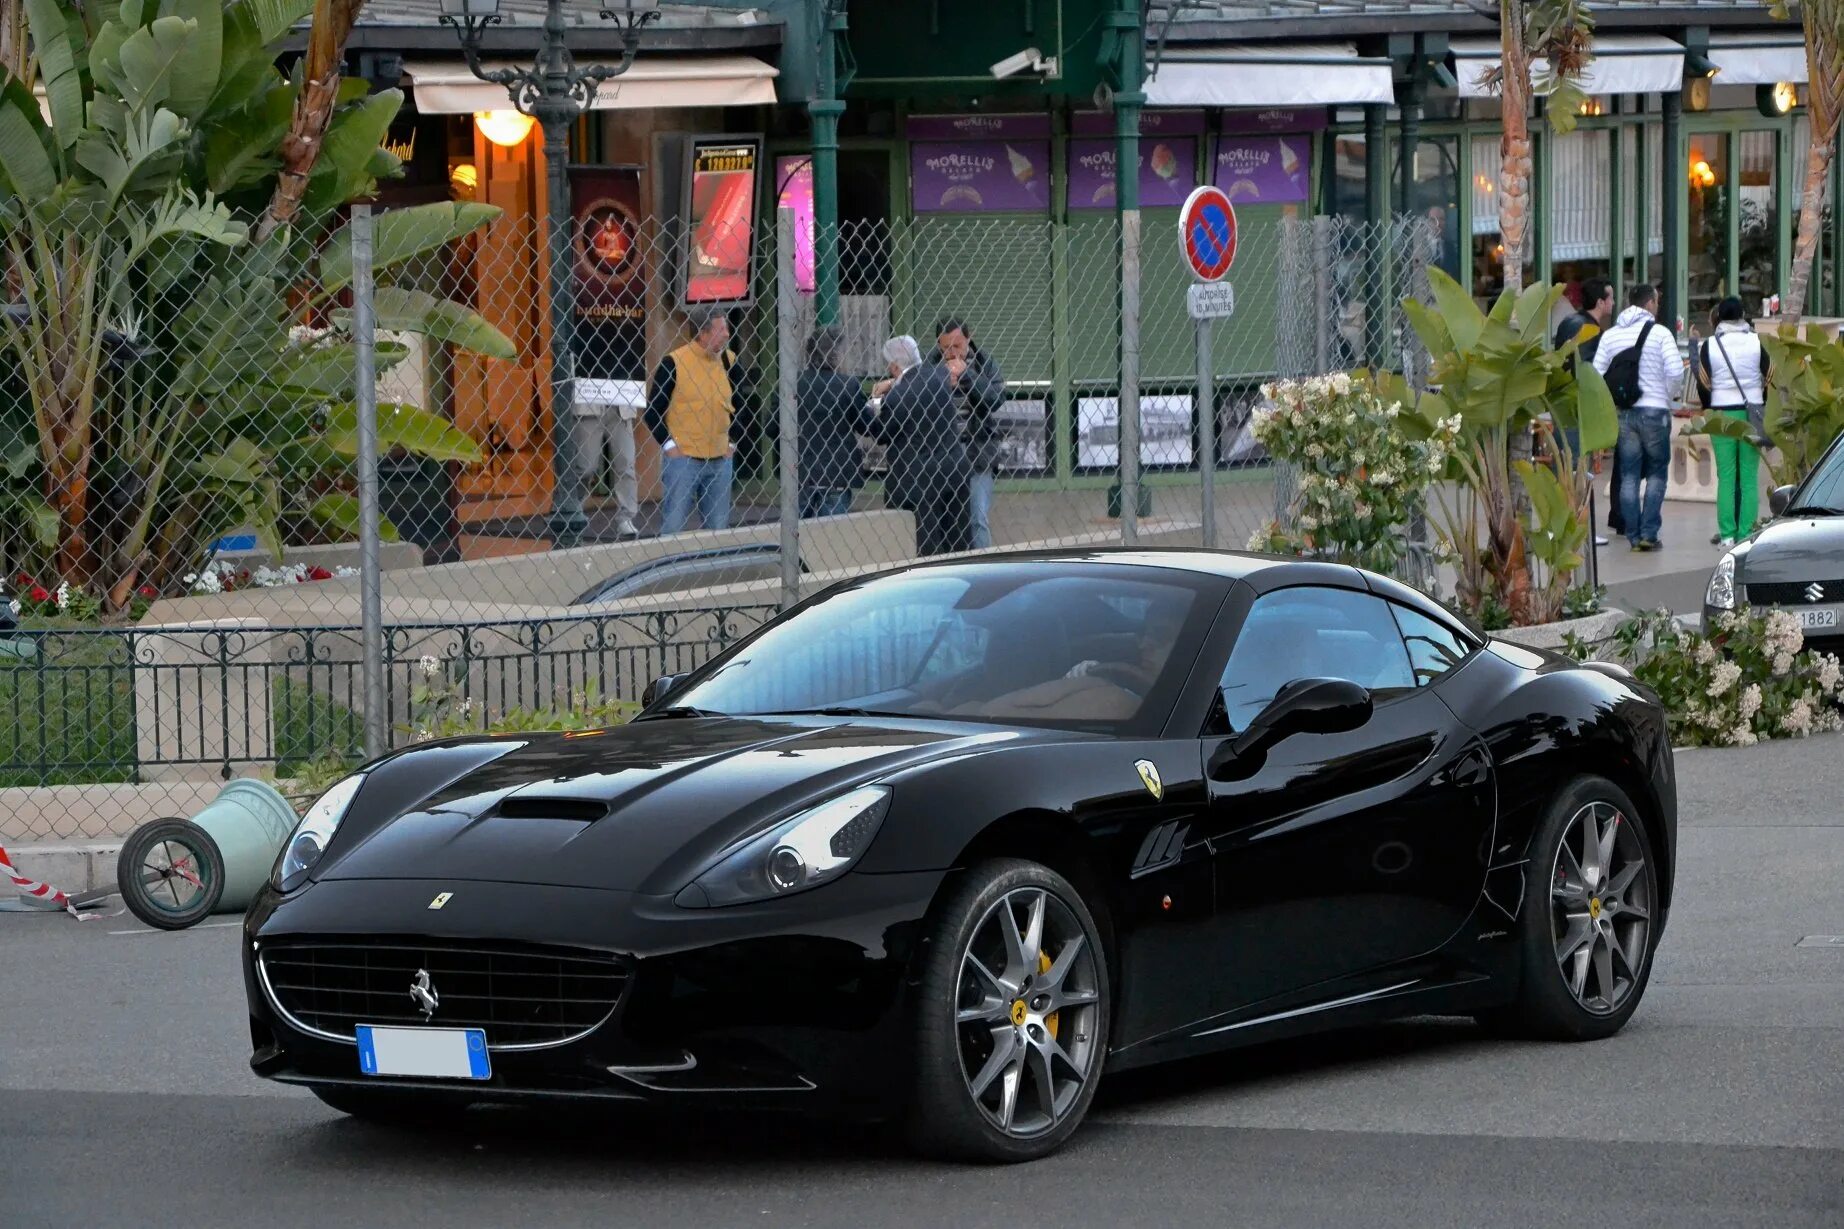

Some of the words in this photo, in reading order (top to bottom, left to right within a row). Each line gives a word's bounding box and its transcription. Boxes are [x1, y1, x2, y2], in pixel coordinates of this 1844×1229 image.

[1196, 303, 1203, 313] 10
[1205, 302, 1232, 312] MINUTES
[1802, 611, 1833, 626] 1882
